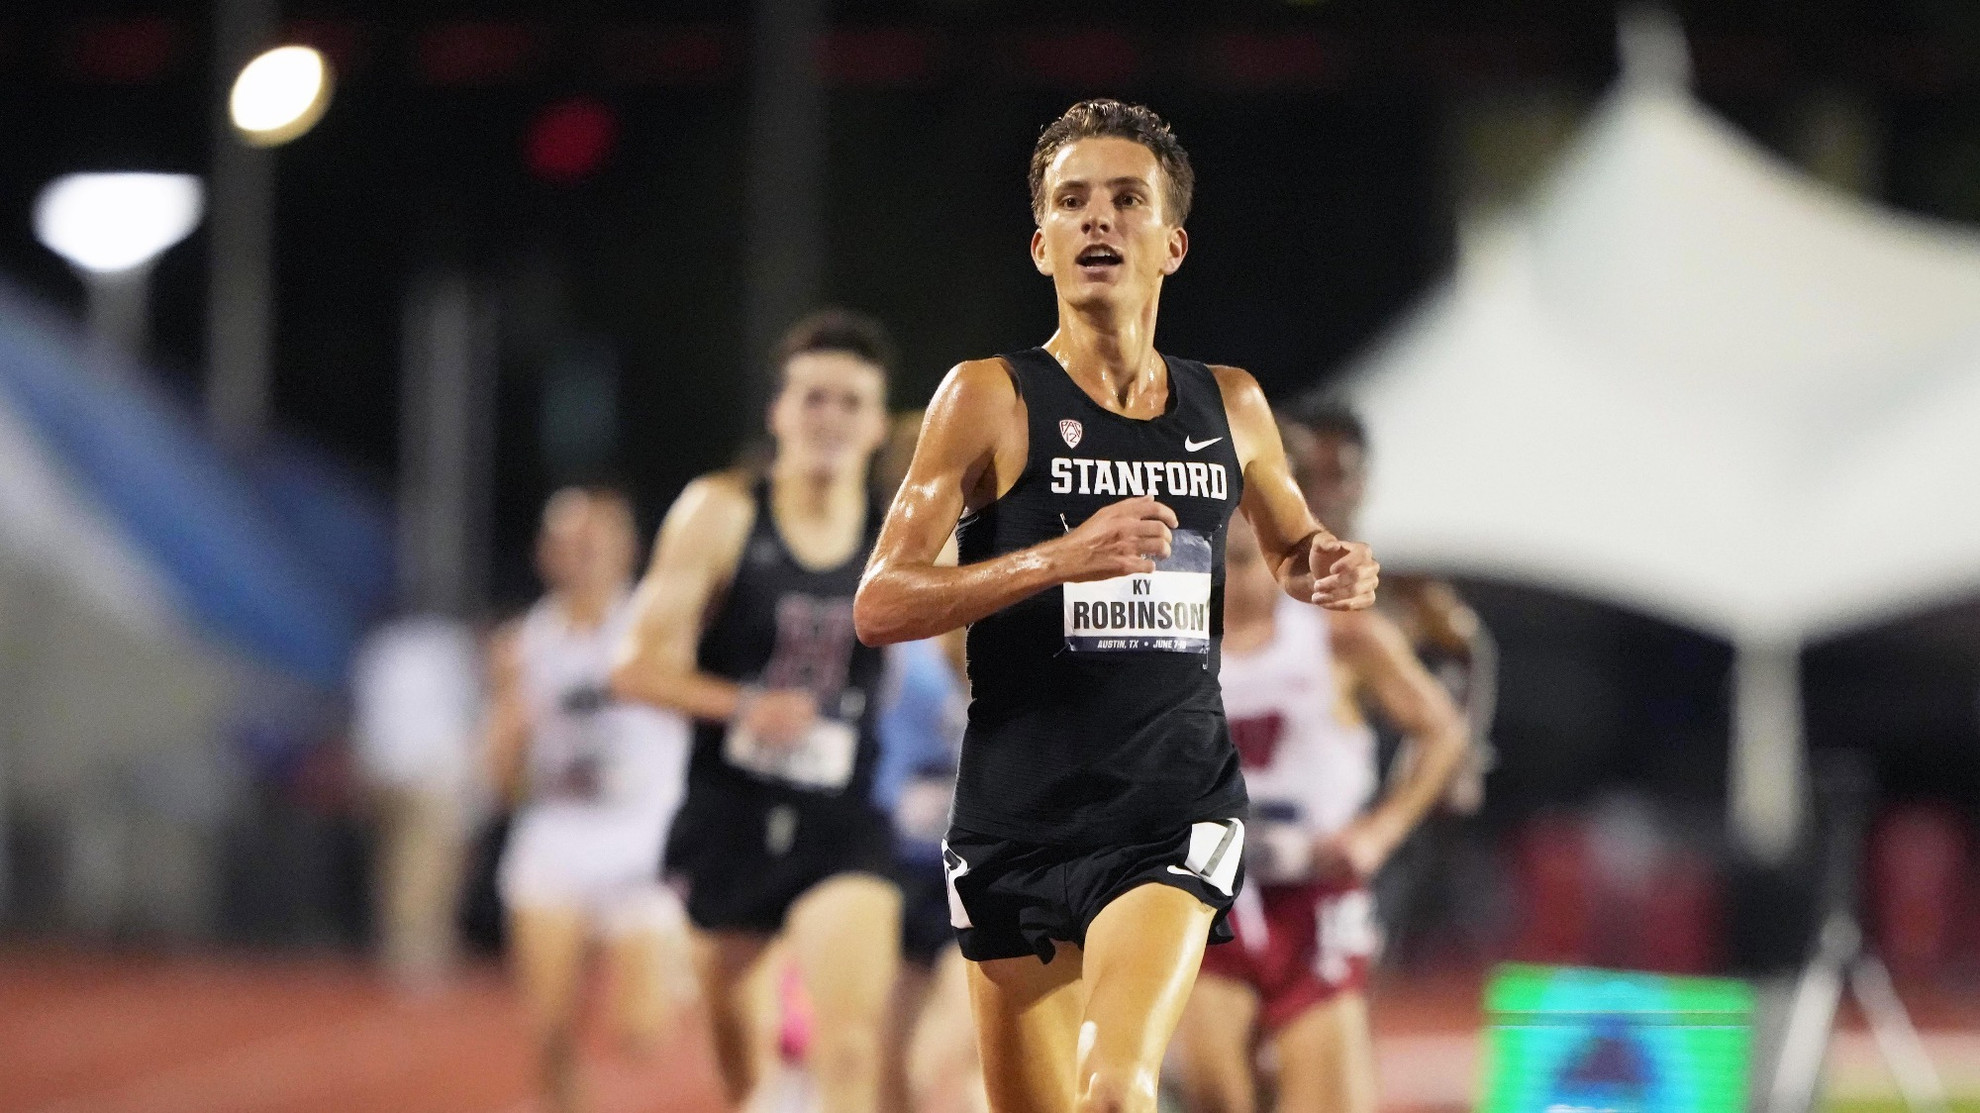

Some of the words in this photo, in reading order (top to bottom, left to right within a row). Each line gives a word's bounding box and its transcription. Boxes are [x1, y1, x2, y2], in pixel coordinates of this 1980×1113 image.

[1060, 421, 1081, 437] PAC
[1066, 432, 1078, 444] 12
[1051, 457, 1227, 500] STANFORD
[1132, 579, 1152, 595] KY
[1073, 601, 1204, 631] ROBINSON
[1097, 639, 1127, 650] AUSTIN,
[1129, 639, 1139, 649] TX
[1152, 639, 1173, 649] JUNE
